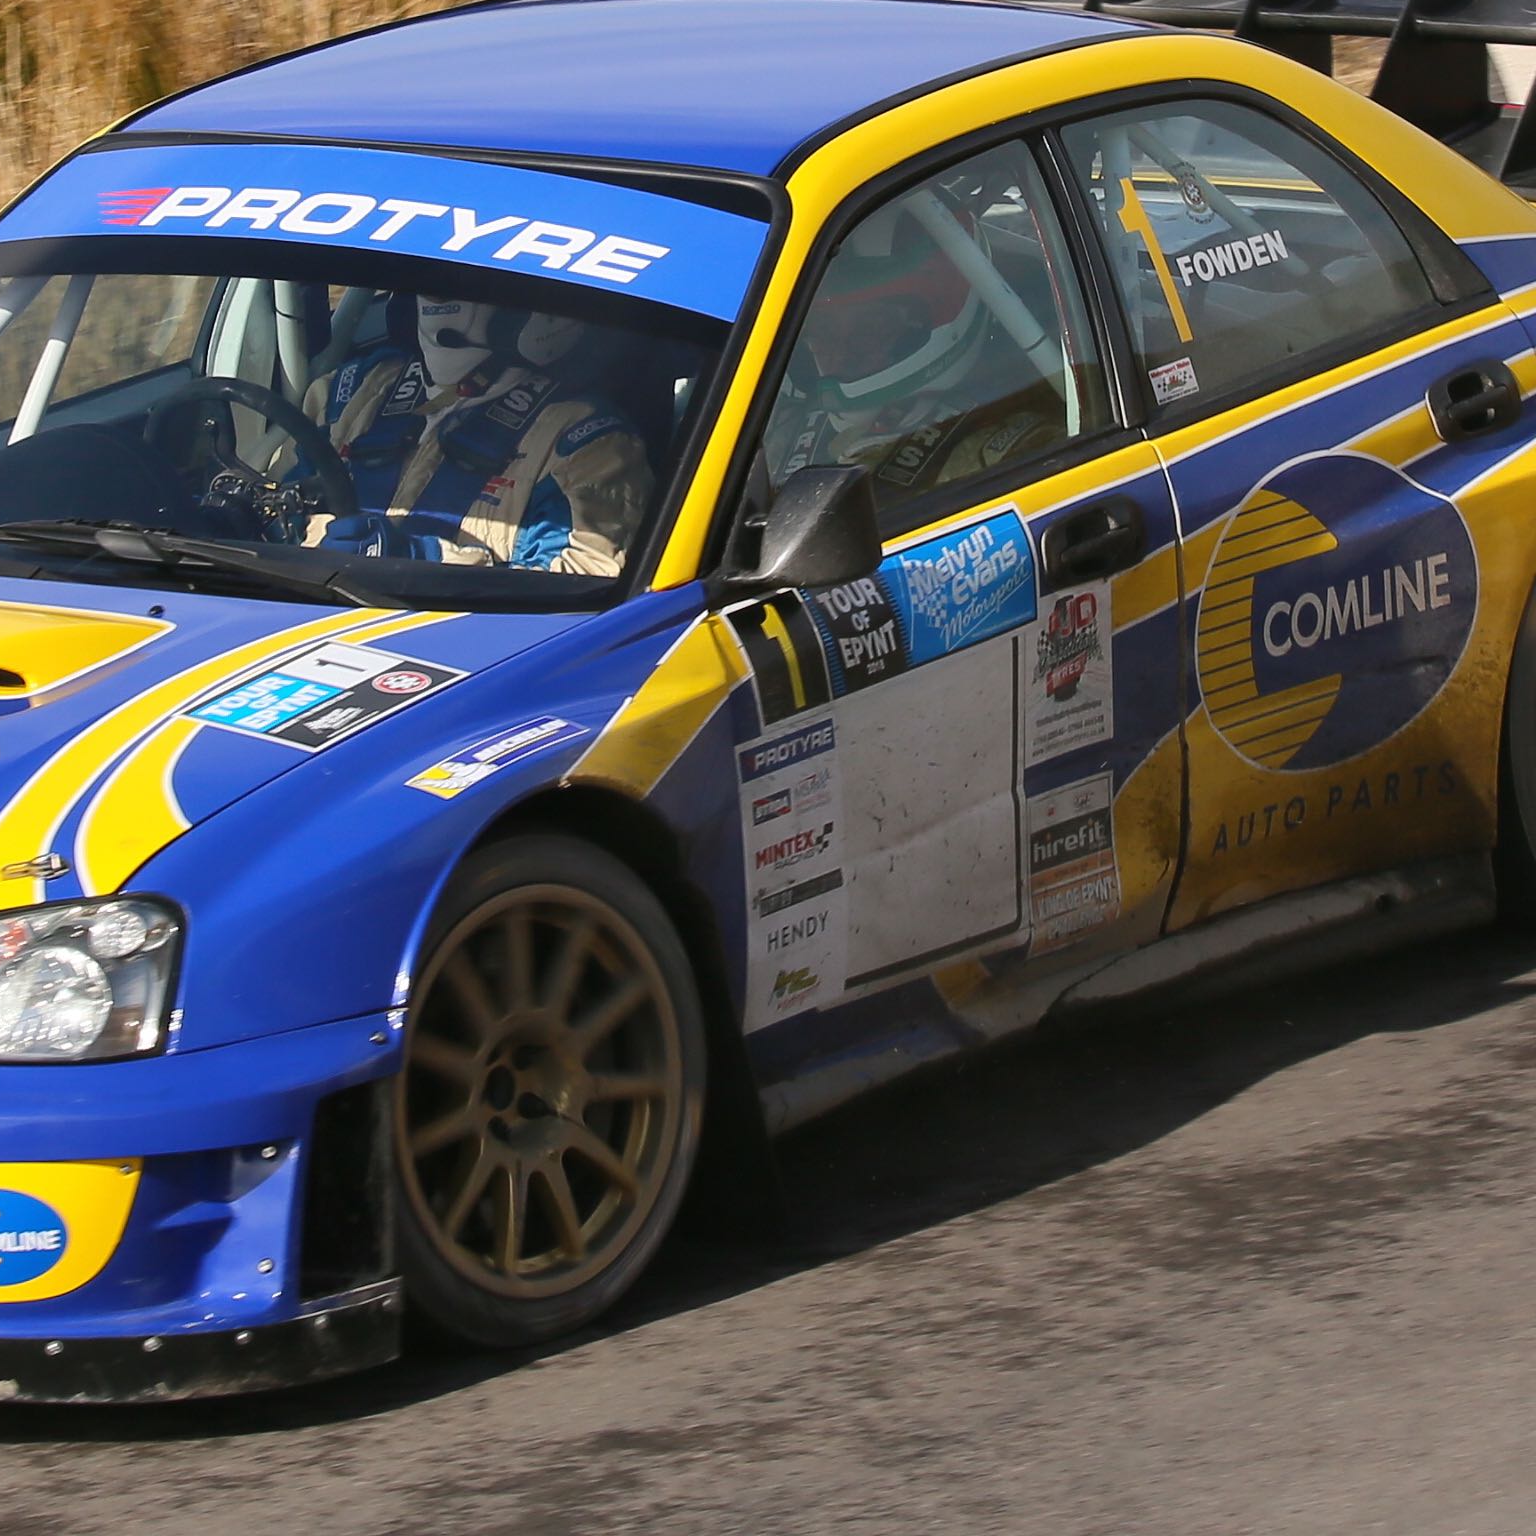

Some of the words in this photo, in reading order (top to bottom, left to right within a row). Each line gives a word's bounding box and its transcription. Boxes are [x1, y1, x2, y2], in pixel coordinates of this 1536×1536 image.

[139, 186, 671, 284] PROTYRE
[1117, 176, 1193, 343] 1
[1175, 229, 1289, 287] FOWDEN
[910, 525, 994, 600] Melvyn
[951, 539, 1017, 606] Evans
[816, 577, 884, 621] TOUR
[851, 610, 872, 632] OF
[1263, 552, 1452, 656] COMLINE
[761, 603, 806, 709] 1
[839, 619, 897, 669] EPYNT
[200, 677, 297, 717] TOUR
[232, 683, 330, 730] EPYNT
[754, 726, 833, 771] PROTYRE
[1212, 796, 1306, 857] AUTO
[1328, 759, 1457, 817] PARTS
[755, 829, 815, 870] MINTEX
[1033, 817, 1106, 863] hirefit
[767, 910, 829, 954] HENDY
